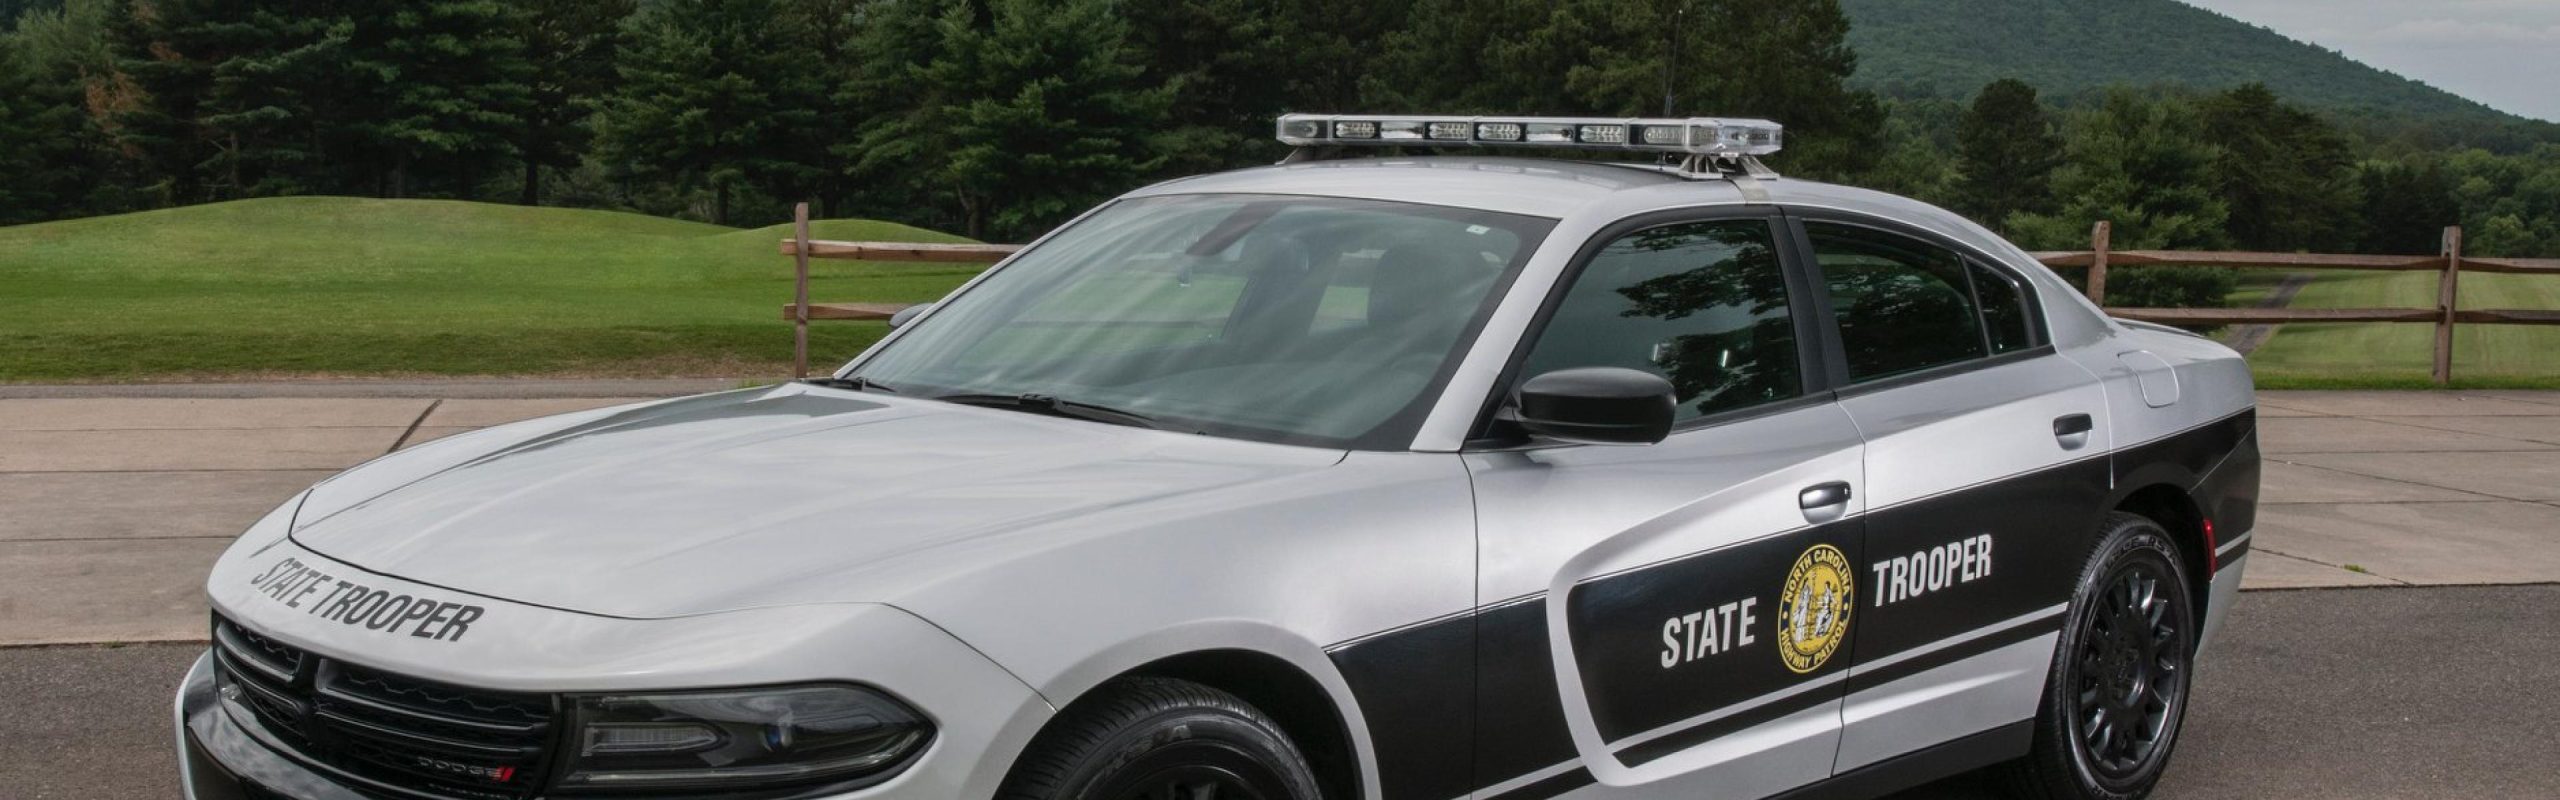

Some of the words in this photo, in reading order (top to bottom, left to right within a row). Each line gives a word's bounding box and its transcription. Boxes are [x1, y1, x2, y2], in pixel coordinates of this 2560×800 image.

[251, 557, 333, 608] STATE
[309, 580, 485, 642] TROOPER
[1661, 597, 1757, 669] STATE
[1873, 534, 1992, 607] TROOPER
[1784, 554, 1812, 602] NORTH
[1814, 549, 1851, 595] CAROLINA
[1781, 629, 1812, 668] HIGHWAY
[1813, 620, 1846, 665] PATROL
[416, 756, 500, 778] DODGE
